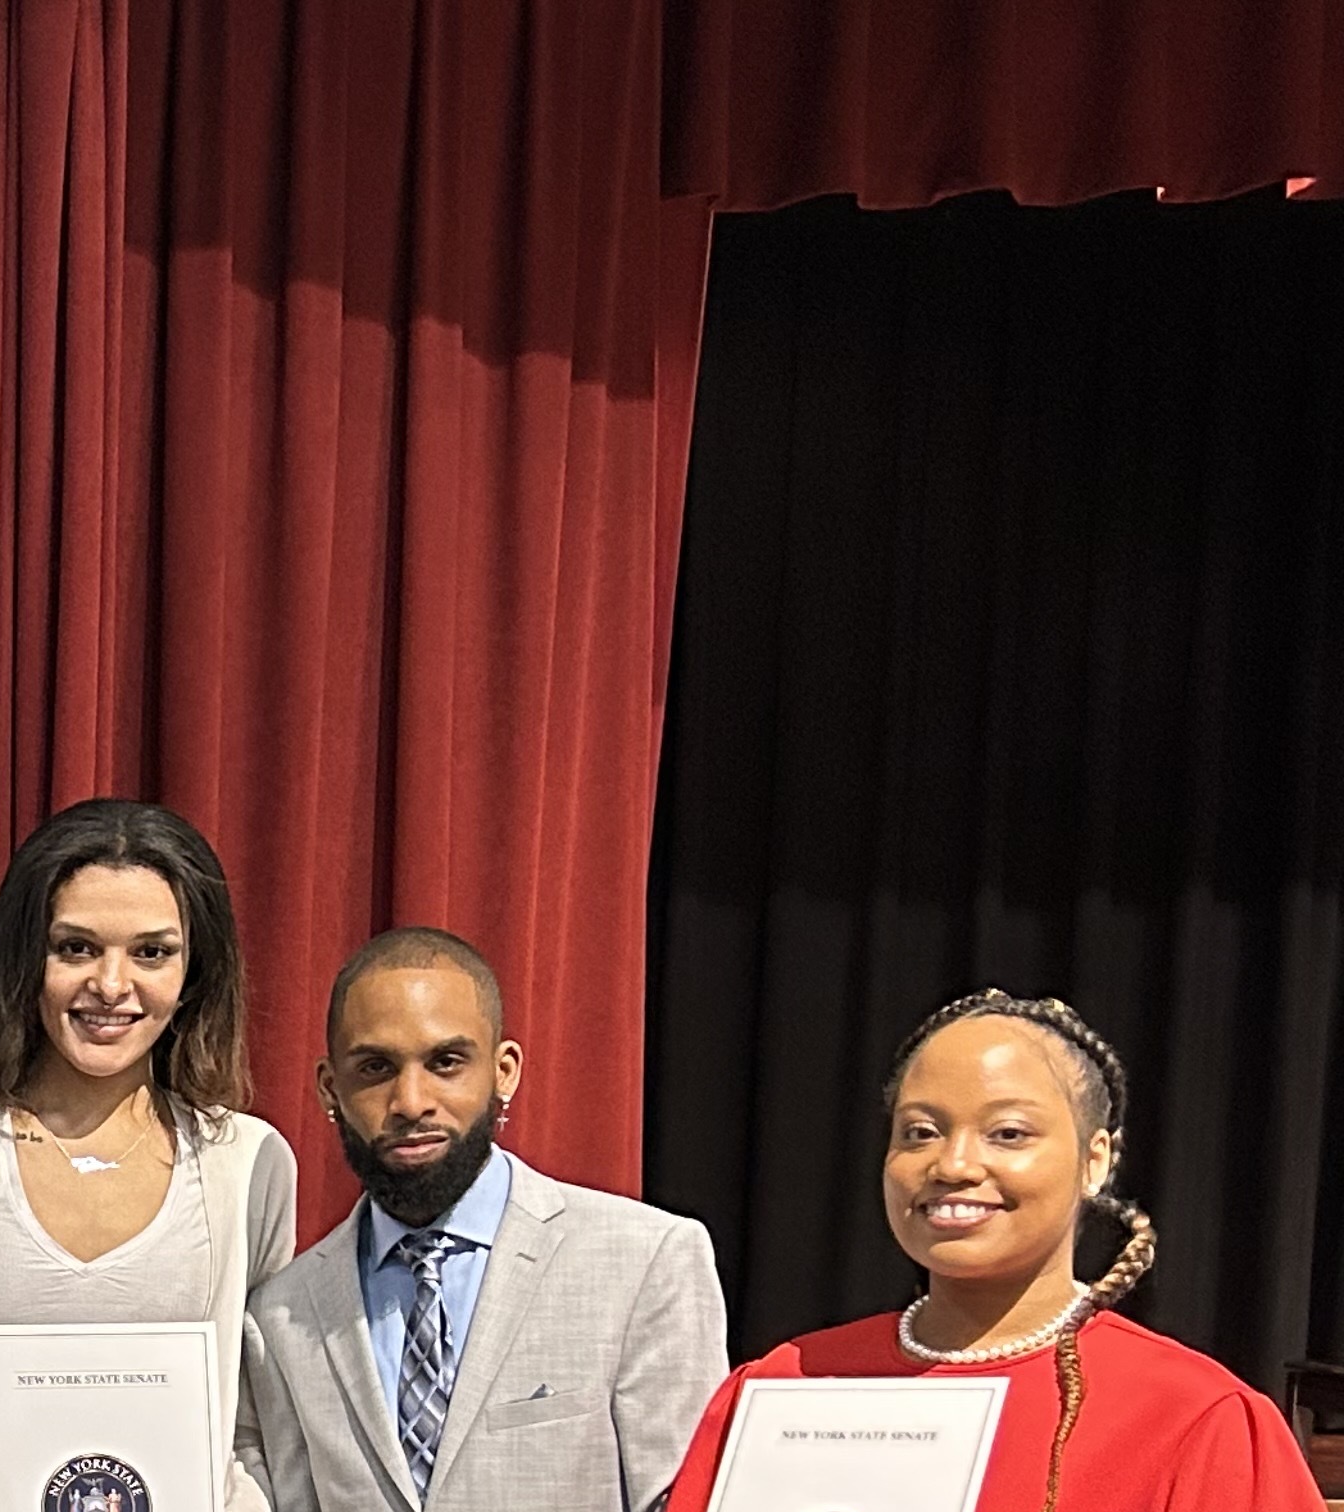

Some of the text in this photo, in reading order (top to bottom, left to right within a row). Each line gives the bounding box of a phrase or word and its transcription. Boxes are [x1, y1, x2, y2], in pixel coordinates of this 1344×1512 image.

[18, 1374, 168, 1385] NEW YORK STATE SENATE
[782, 1430, 938, 1441] NEW YORK STATE SENATE
[49, 1458, 144, 1497] NEW YORK STATE
